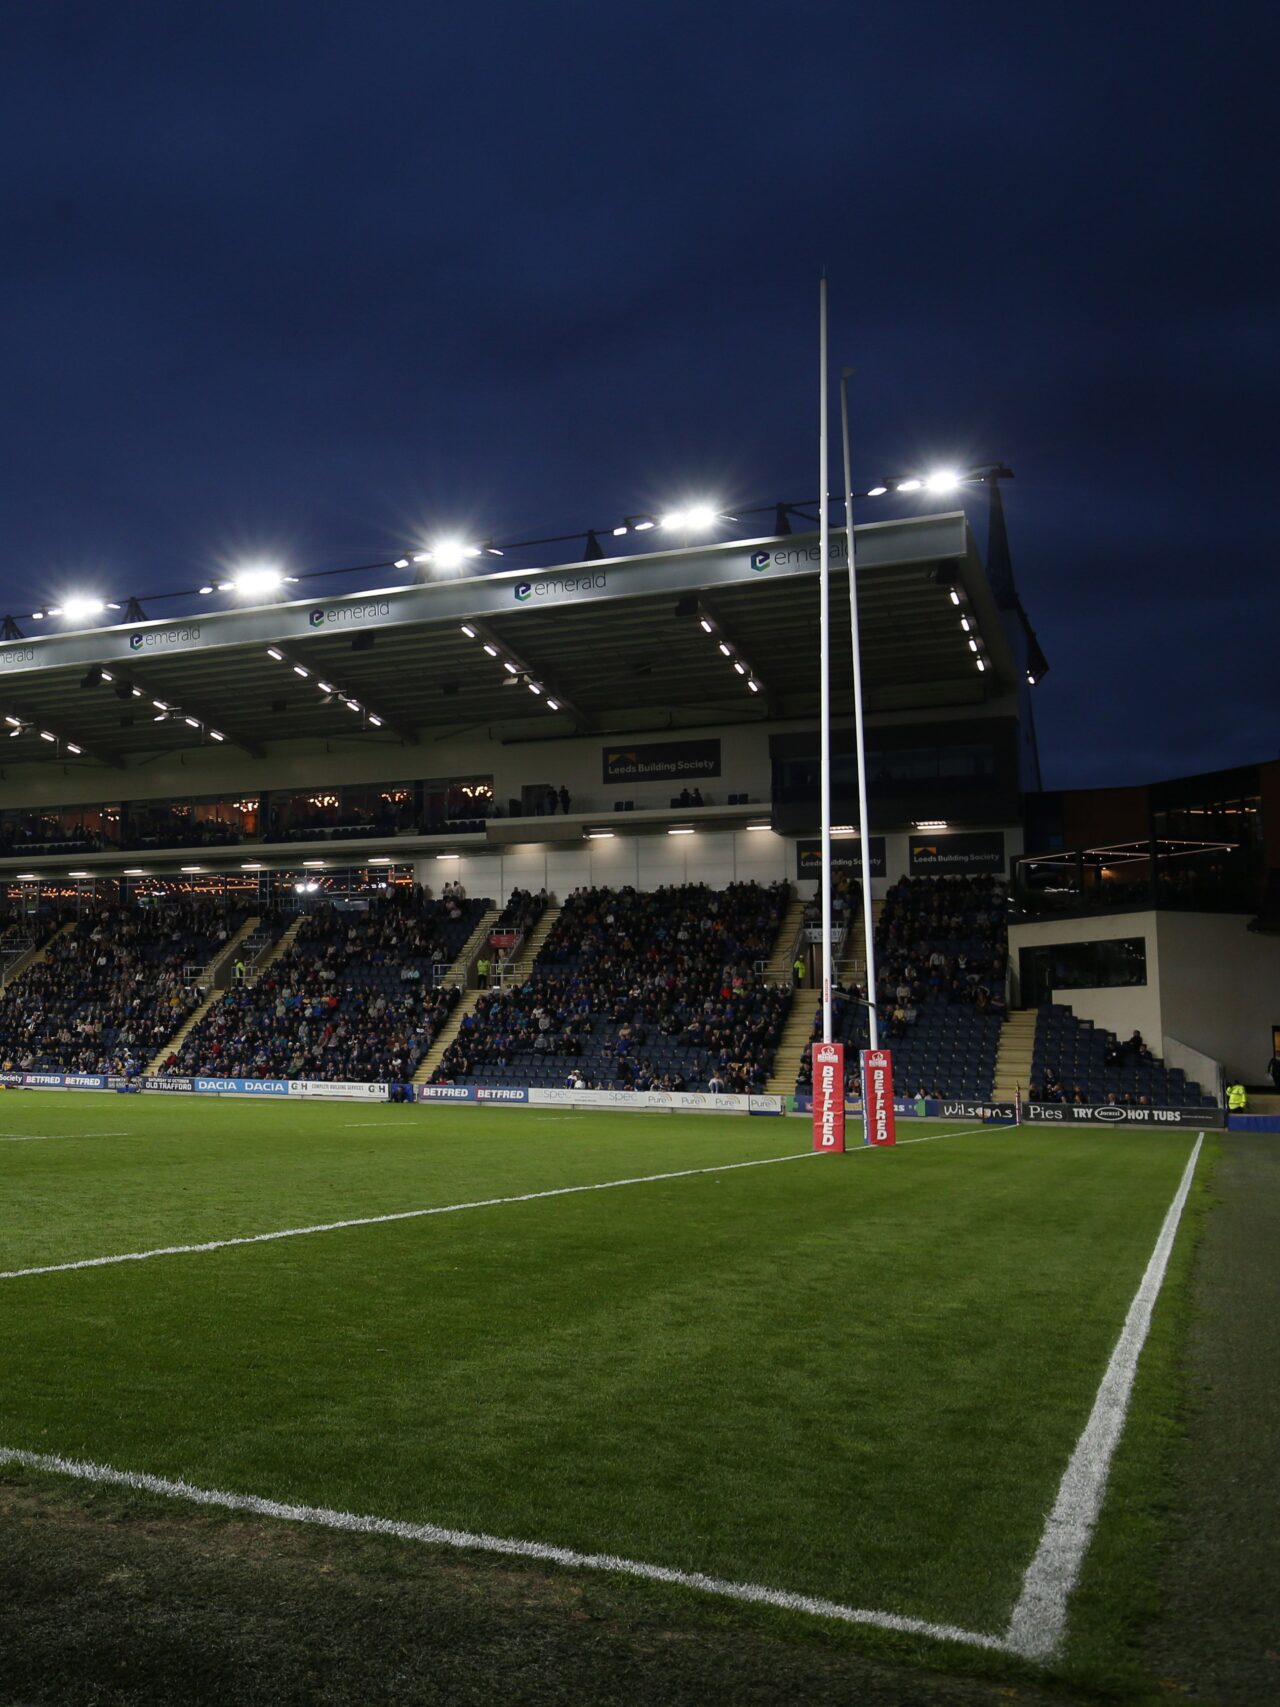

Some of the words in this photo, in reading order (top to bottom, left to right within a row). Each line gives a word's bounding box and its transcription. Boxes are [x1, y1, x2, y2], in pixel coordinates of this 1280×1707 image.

[534, 571, 606, 596] emerald
[326, 599, 389, 623] emerald
[145, 625, 201, 647] emerald
[608, 765, 637, 775] Leeds
[638, 762, 676, 773] Building
[677, 759, 715, 770] Society
[913, 855, 937, 863] Leeds
[937, 854, 968, 864] Building
[969, 852, 1000, 863] Society
[0, 1073, 23, 1083] Society
[26, 1074, 61, 1084] BETFRED
[65, 1075, 101, 1086] BETFRED
[145, 1081, 158, 1089] OLD
[158, 1082, 192, 1090] TRAFFORD
[198, 1080, 237, 1090] DACIA
[244, 1081, 285, 1092] DACIA
[423, 1087, 468, 1097] BETFRED
[477, 1088, 524, 1099] BETFRED
[648, 1095, 666, 1104] Pure
[681, 1096, 701, 1105] Pure
[715, 1096, 735, 1106] Pure
[751, 1098, 770, 1107] Pure
[821, 1065, 835, 1146] BETFRED
[873, 1069, 887, 1140] BETFRED
[1029, 1105, 1063, 1119] Pies
[1073, 1107, 1093, 1118] TRY
[1127, 1109, 1149, 1120] HOT
[1153, 1110, 1181, 1121] TUBS
